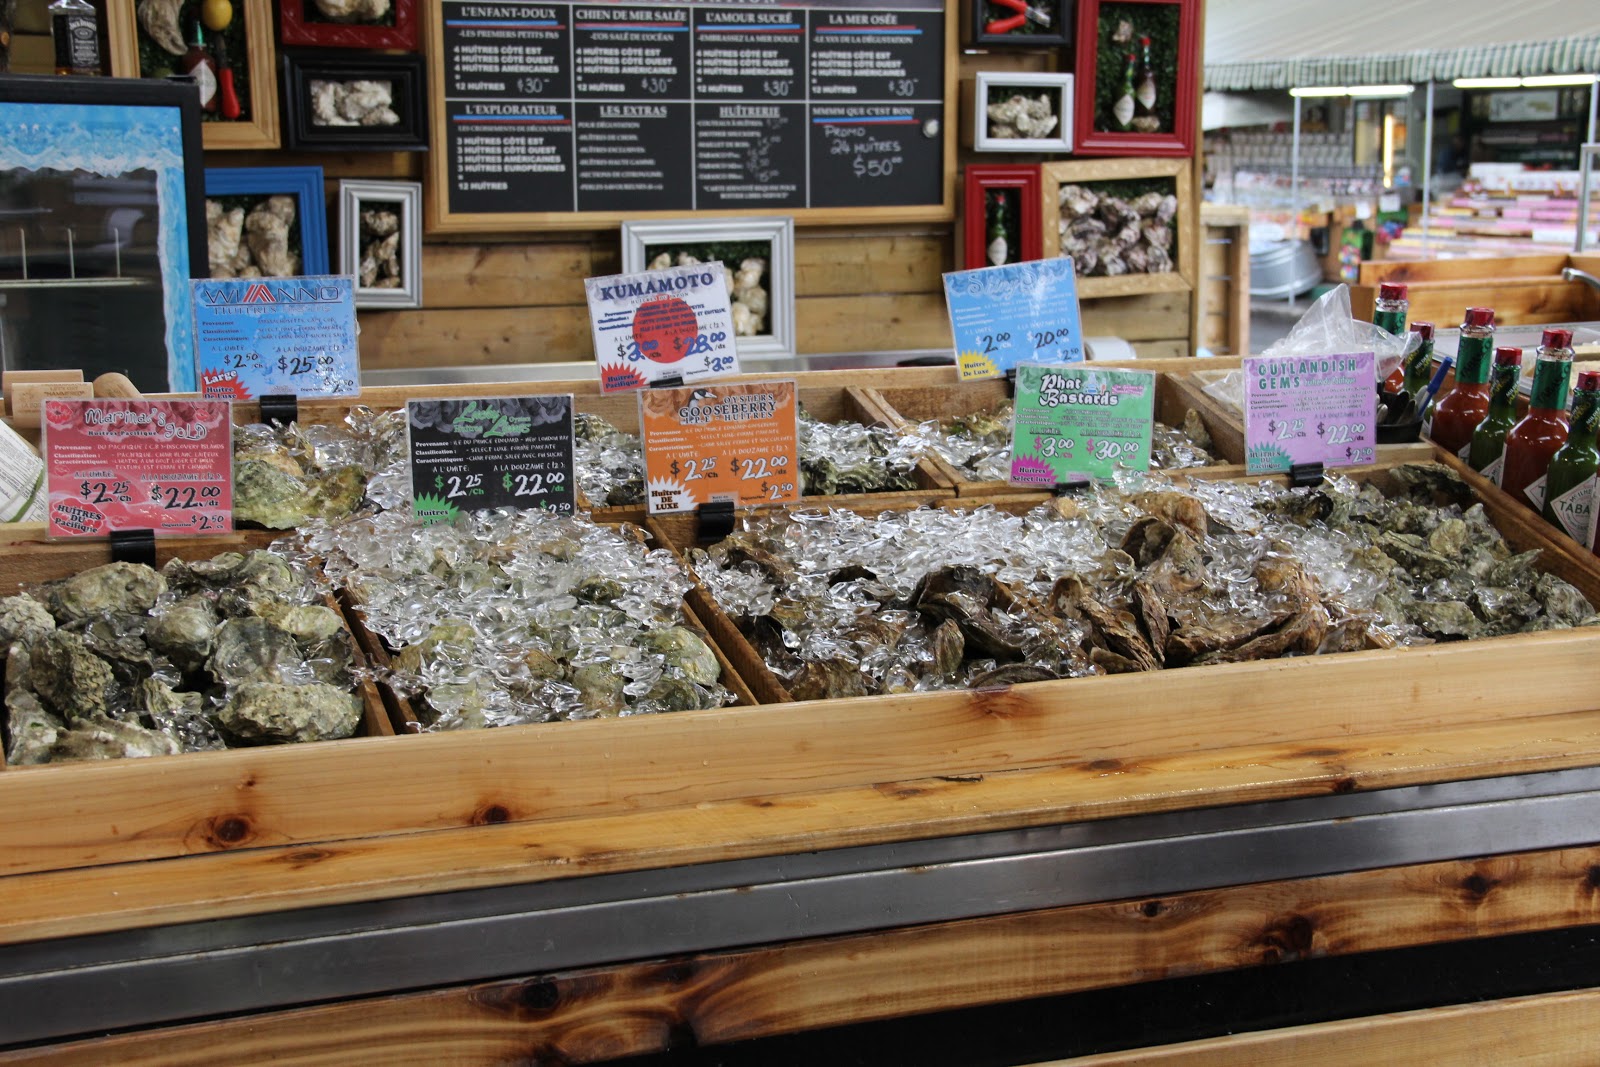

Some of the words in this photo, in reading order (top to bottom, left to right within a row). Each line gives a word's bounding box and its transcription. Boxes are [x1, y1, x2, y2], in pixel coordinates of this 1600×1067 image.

[461, 6, 556, 18] L'ENFANT-DOUX
[576, 9, 610, 20] CHIEN
[612, 10, 628, 20] DE
[629, 11, 652, 21] MER
[654, 10, 687, 21] SALÉE
[706, 12, 755, 22] L'AMOUR
[757, 12, 792, 23] SUCRÉ
[829, 14, 843, 24] LA
[845, 14, 868, 24] MER
[870, 13, 898, 24] OSÉE
[465, 105, 557, 115] L'EXPLORATEUR
[600, 106, 620, 116] LES
[623, 106, 668, 116] EXTRAS
[846, 108, 865, 116] QUE
[830, 139, 851, 155] 24
[206, 284, 339, 303] WIANNO
[601, 273, 714, 301] KUMAMOTO
[1258, 359, 1356, 376] OUTLANDISH
[204, 370, 237, 384] Large
[1040, 374, 1082, 392] Phat
[1259, 377, 1300, 390] GEMS
[724, 394, 774, 404] OYSTERS
[1039, 389, 1119, 408] Bastards
[453, 401, 501, 424] Lucky
[679, 401, 776, 418] GOOSEBERRY
[85, 408, 166, 426] Marina's
[1086, 438, 1139, 461] $30.00
[1559, 500, 1591, 514] TABA
[55, 517, 98, 534] Pacifique
[70, 515, 86, 523] DU
